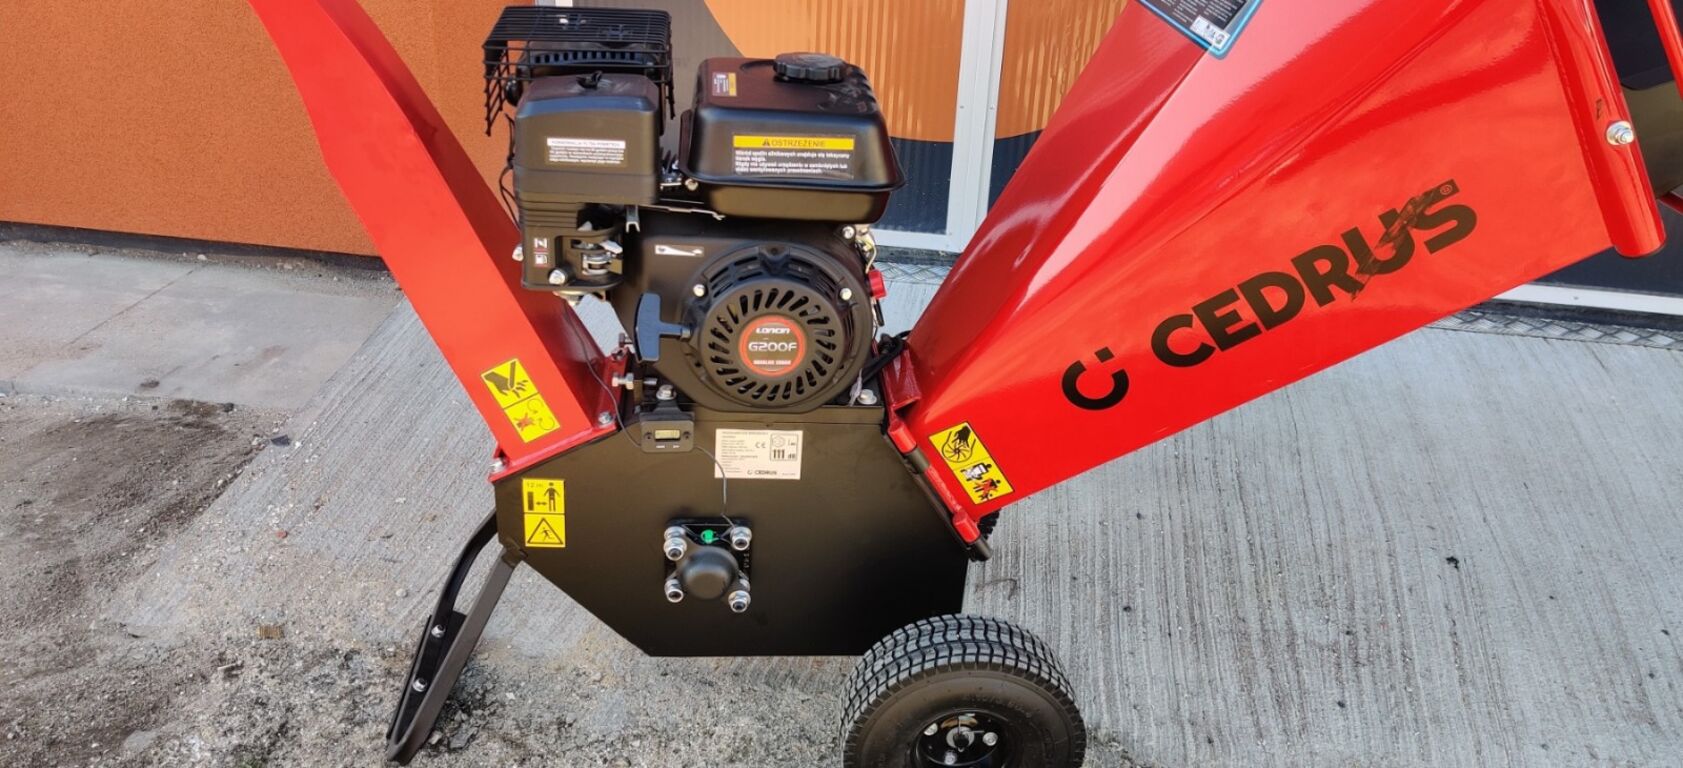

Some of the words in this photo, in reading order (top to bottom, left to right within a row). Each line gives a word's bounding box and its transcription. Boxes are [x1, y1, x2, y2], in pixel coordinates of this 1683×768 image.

[771, 138, 825, 148] OSTRZEŻENIE
[1151, 179, 1478, 368] CEDRUS
[748, 341, 798, 352] G200F
[773, 449, 785, 459] 111
